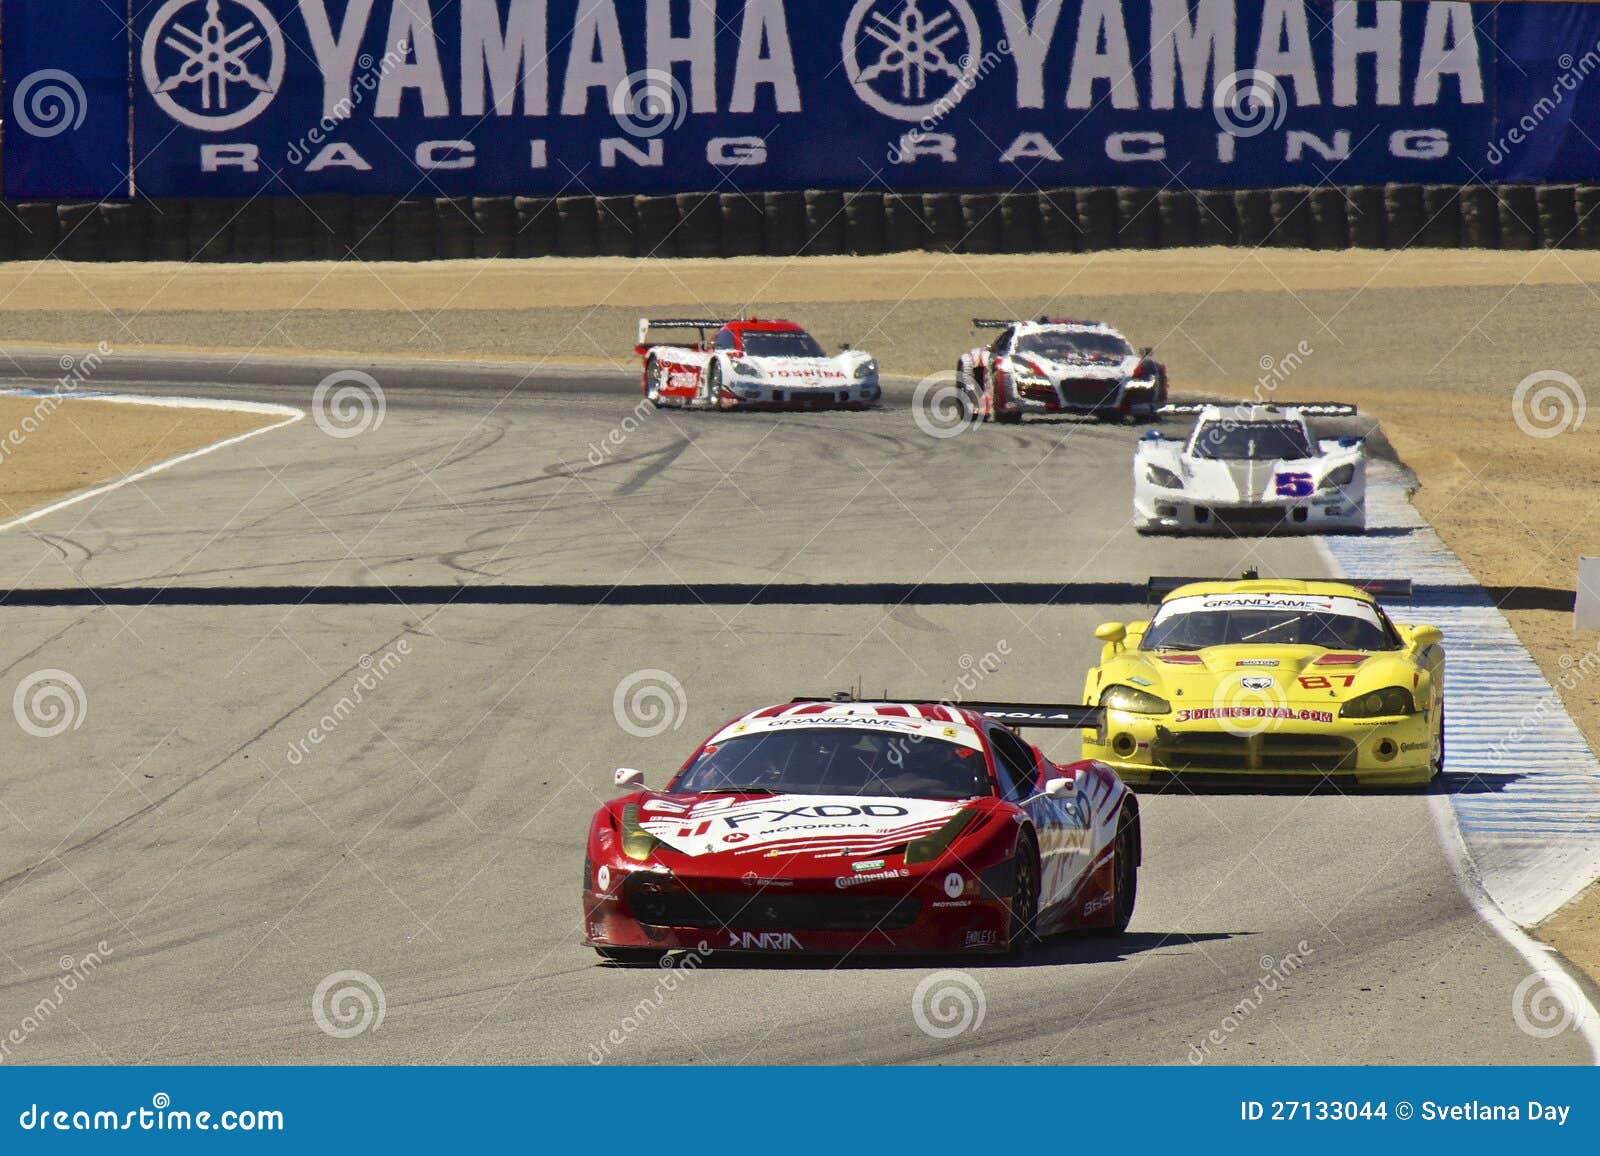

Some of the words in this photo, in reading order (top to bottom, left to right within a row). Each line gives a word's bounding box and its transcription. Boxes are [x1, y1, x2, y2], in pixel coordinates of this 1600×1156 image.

[299, 0, 802, 118] YAMAHA
[999, 0, 1485, 110] YAMAHA
[200, 136, 768, 172] RACING
[900, 129, 1450, 163] RACING
[768, 369, 847, 379] TOSHIBA
[1275, 472, 1315, 497] 5
[1298, 675, 1355, 689] 87
[723, 804, 908, 828] FXDD
[760, 823, 869, 835] MOTOROLA
[835, 868, 899, 889] Continental
